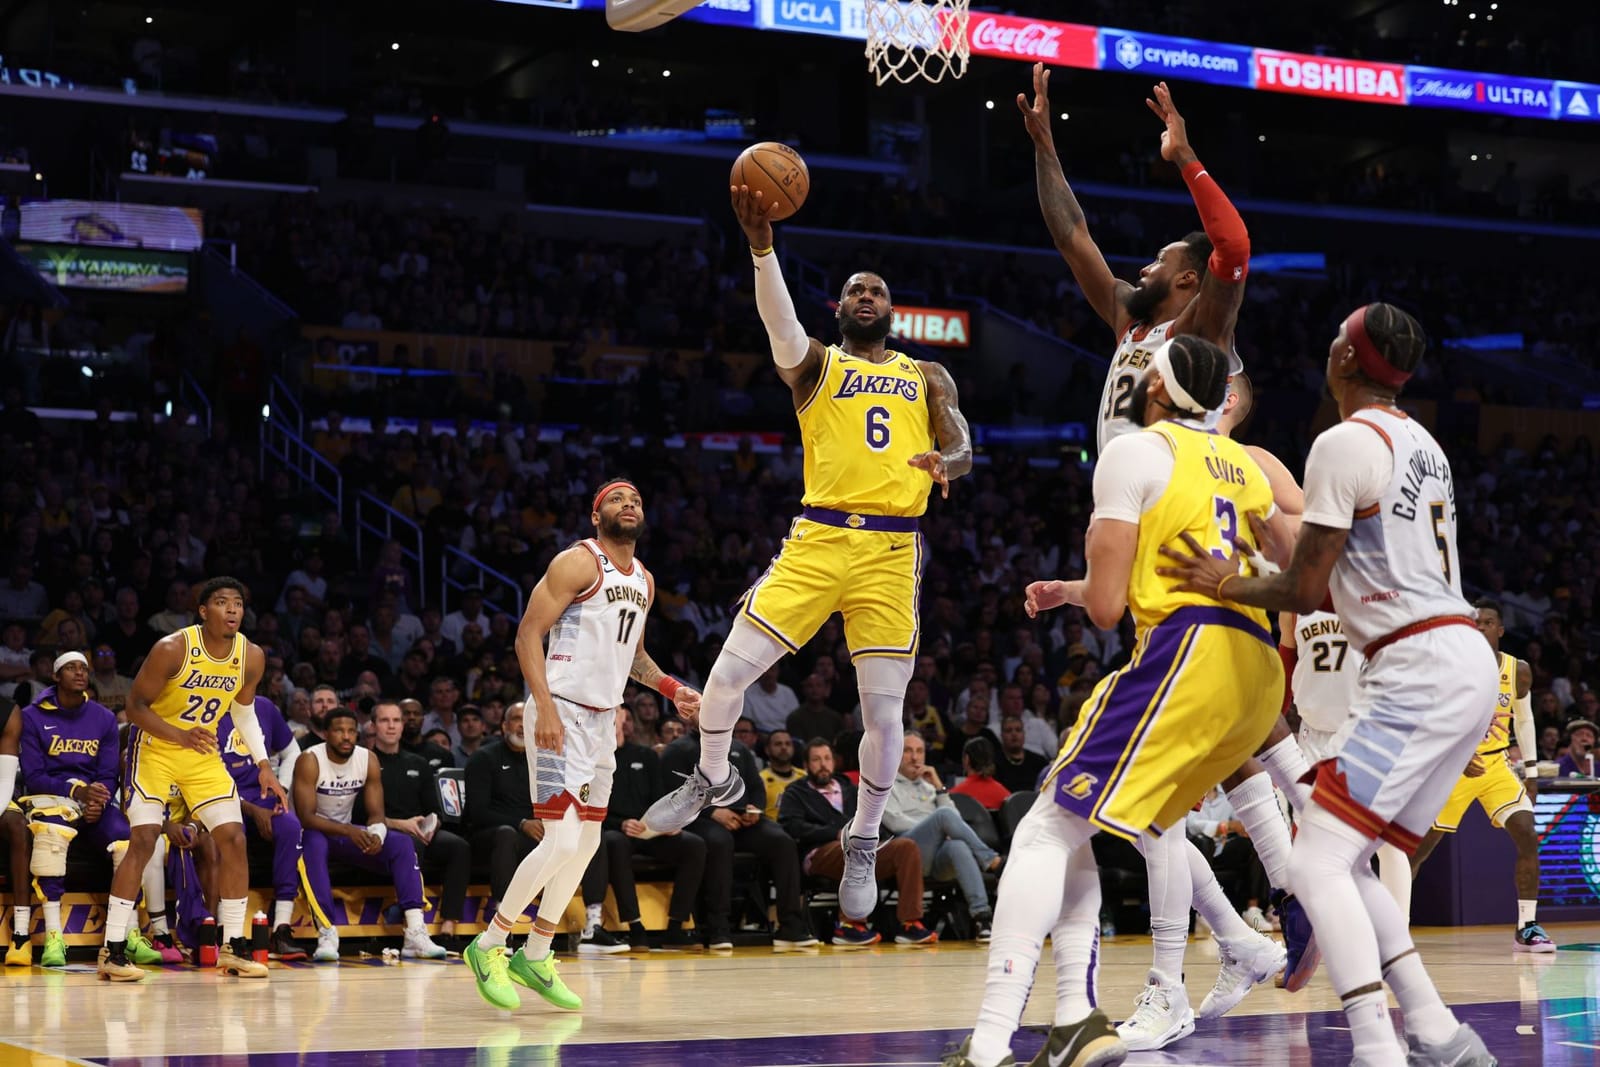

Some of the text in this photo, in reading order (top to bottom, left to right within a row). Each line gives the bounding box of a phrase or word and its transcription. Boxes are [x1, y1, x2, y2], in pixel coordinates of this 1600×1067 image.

[780, 1, 835, 25] UCLA
[1144, 47, 1239, 72] crypto.com
[1260, 55, 1400, 98] TOSHIBA
[1487, 84, 1549, 108] ULTRA
[889, 312, 967, 344] HIBA
[1117, 348, 1154, 371] VER
[832, 368, 919, 402] LAKERS
[865, 405, 891, 452] 6
[1210, 496, 1241, 566] 3
[1428, 500, 1451, 587] 5
[604, 584, 649, 611] DENVER
[617, 608, 638, 645] 11
[1300, 619, 1345, 642] DENV
[1312, 640, 1349, 673] 27
[178, 669, 239, 692] LAKERS
[179, 693, 222, 725] 28
[48, 734, 100, 757] LAKERS
